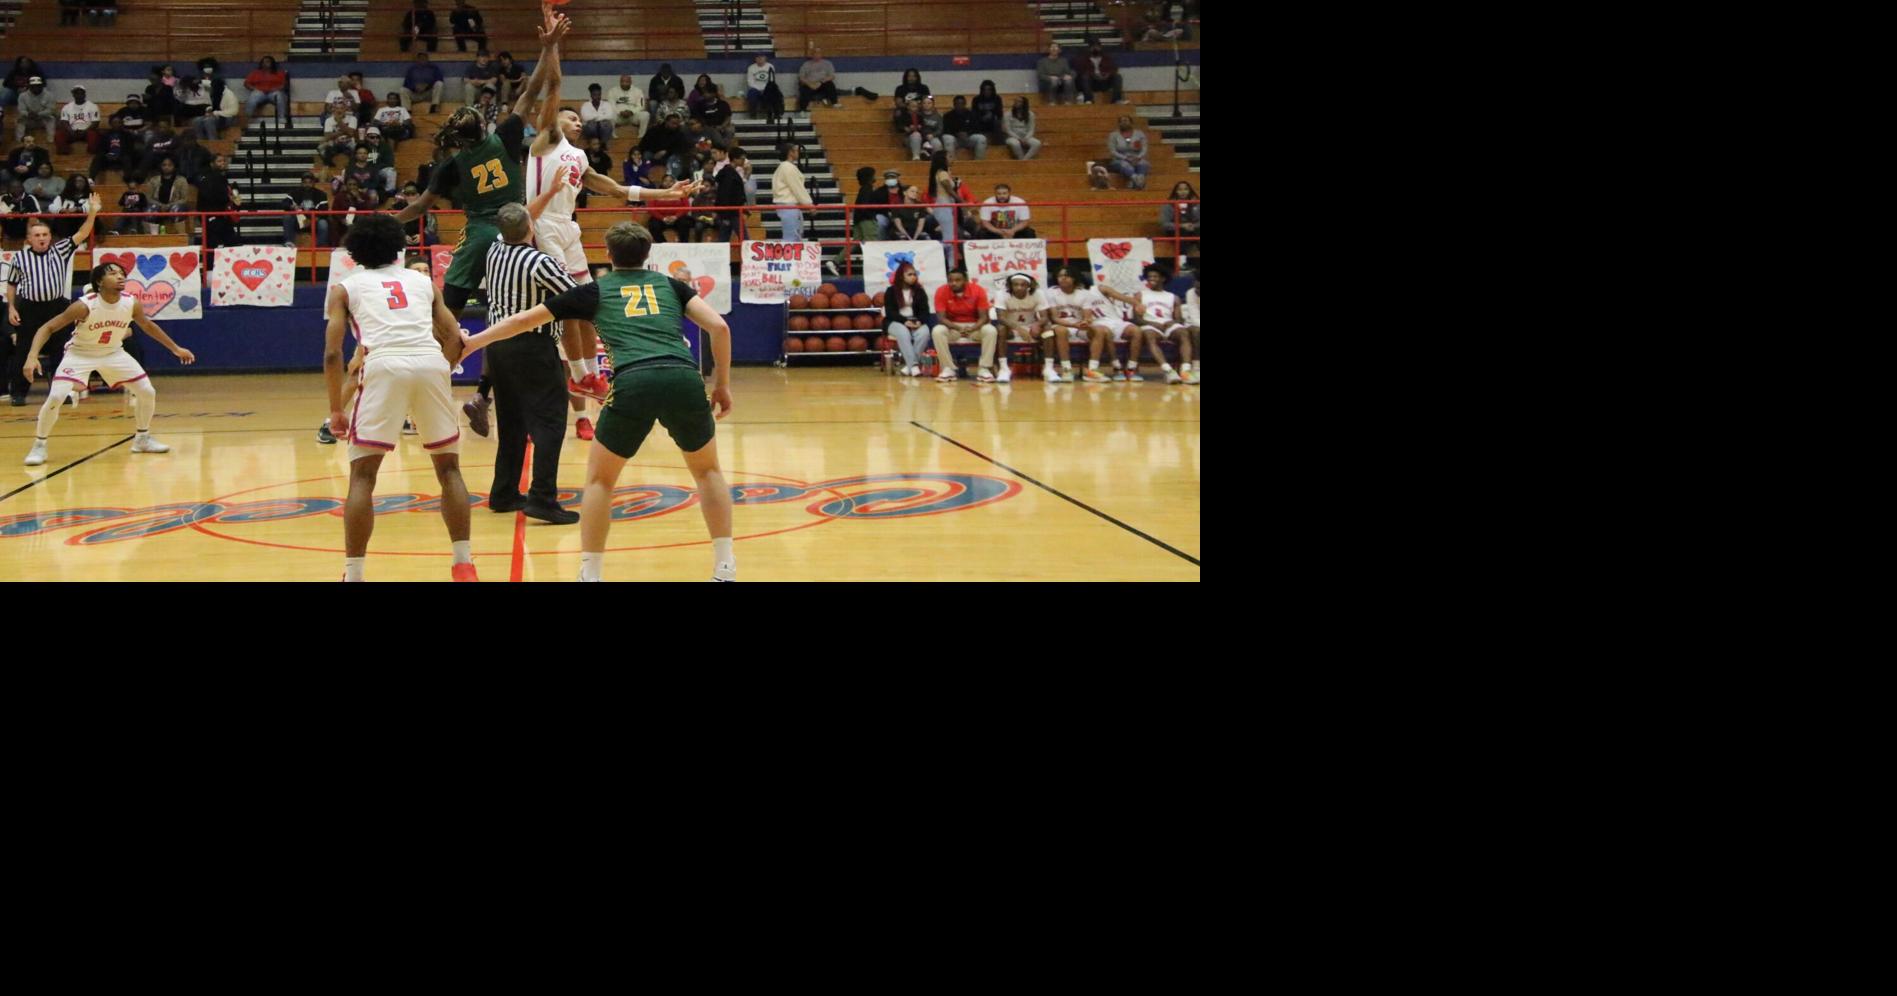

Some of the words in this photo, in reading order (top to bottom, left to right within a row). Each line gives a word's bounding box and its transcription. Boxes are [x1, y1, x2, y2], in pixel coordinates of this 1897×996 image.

[471, 158, 509, 194] 23
[751, 241, 804, 261] SHOOT
[978, 258, 1043, 275] HEART
[381, 280, 408, 310] 3
[620, 284, 660, 318] 21
[88, 320, 128, 331] COLONELS
[98, 331, 113, 345] 5
[0, 471, 1023, 547] Colnels
